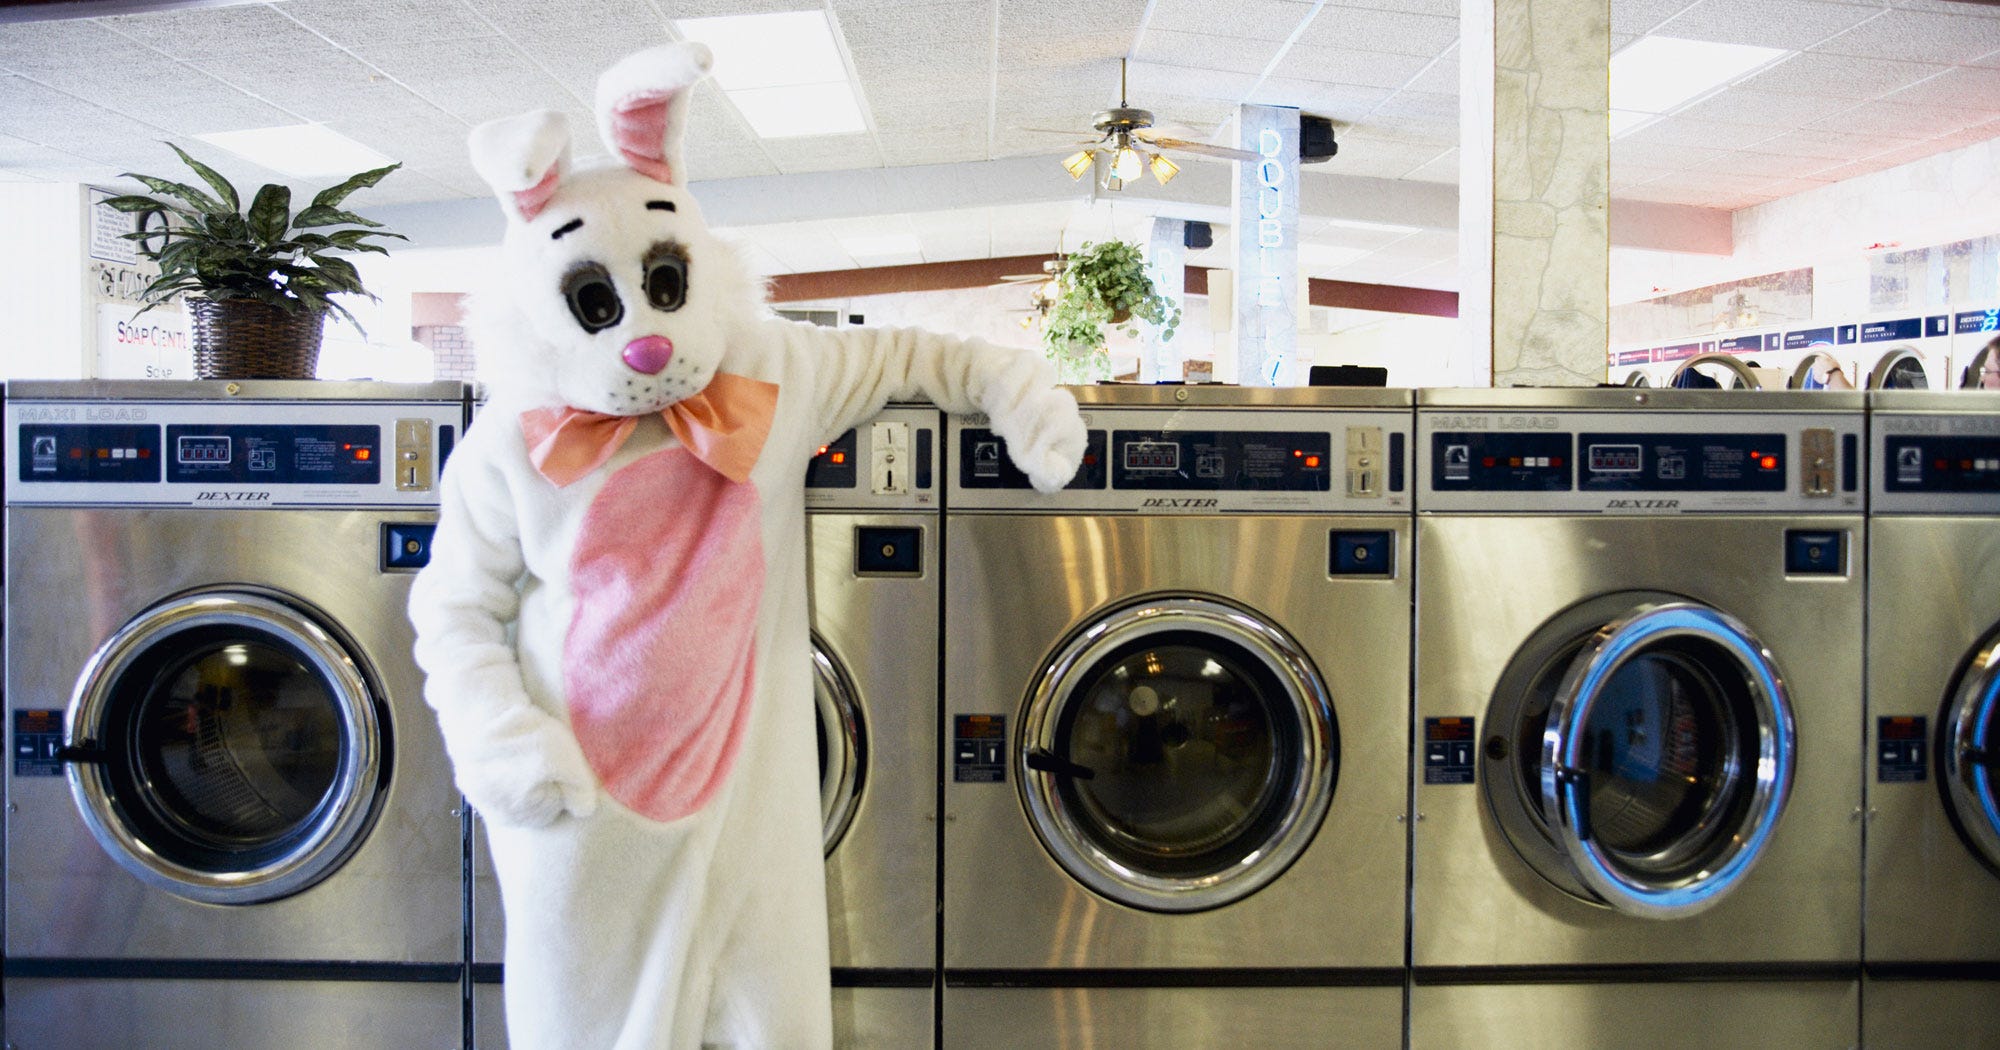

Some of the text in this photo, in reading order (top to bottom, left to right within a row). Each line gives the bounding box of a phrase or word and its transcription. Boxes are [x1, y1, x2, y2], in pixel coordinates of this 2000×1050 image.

[117, 320, 149, 345] SOAP
[146, 365, 173, 378] SOAP
[19, 408, 148, 421] MAXI LOAD
[1430, 416, 1560, 430] MAXI LOAD
[196, 491, 271, 501] DEXTER
[1142, 498, 1218, 507] DEXTER
[1606, 499, 1680, 508] DEXTER
